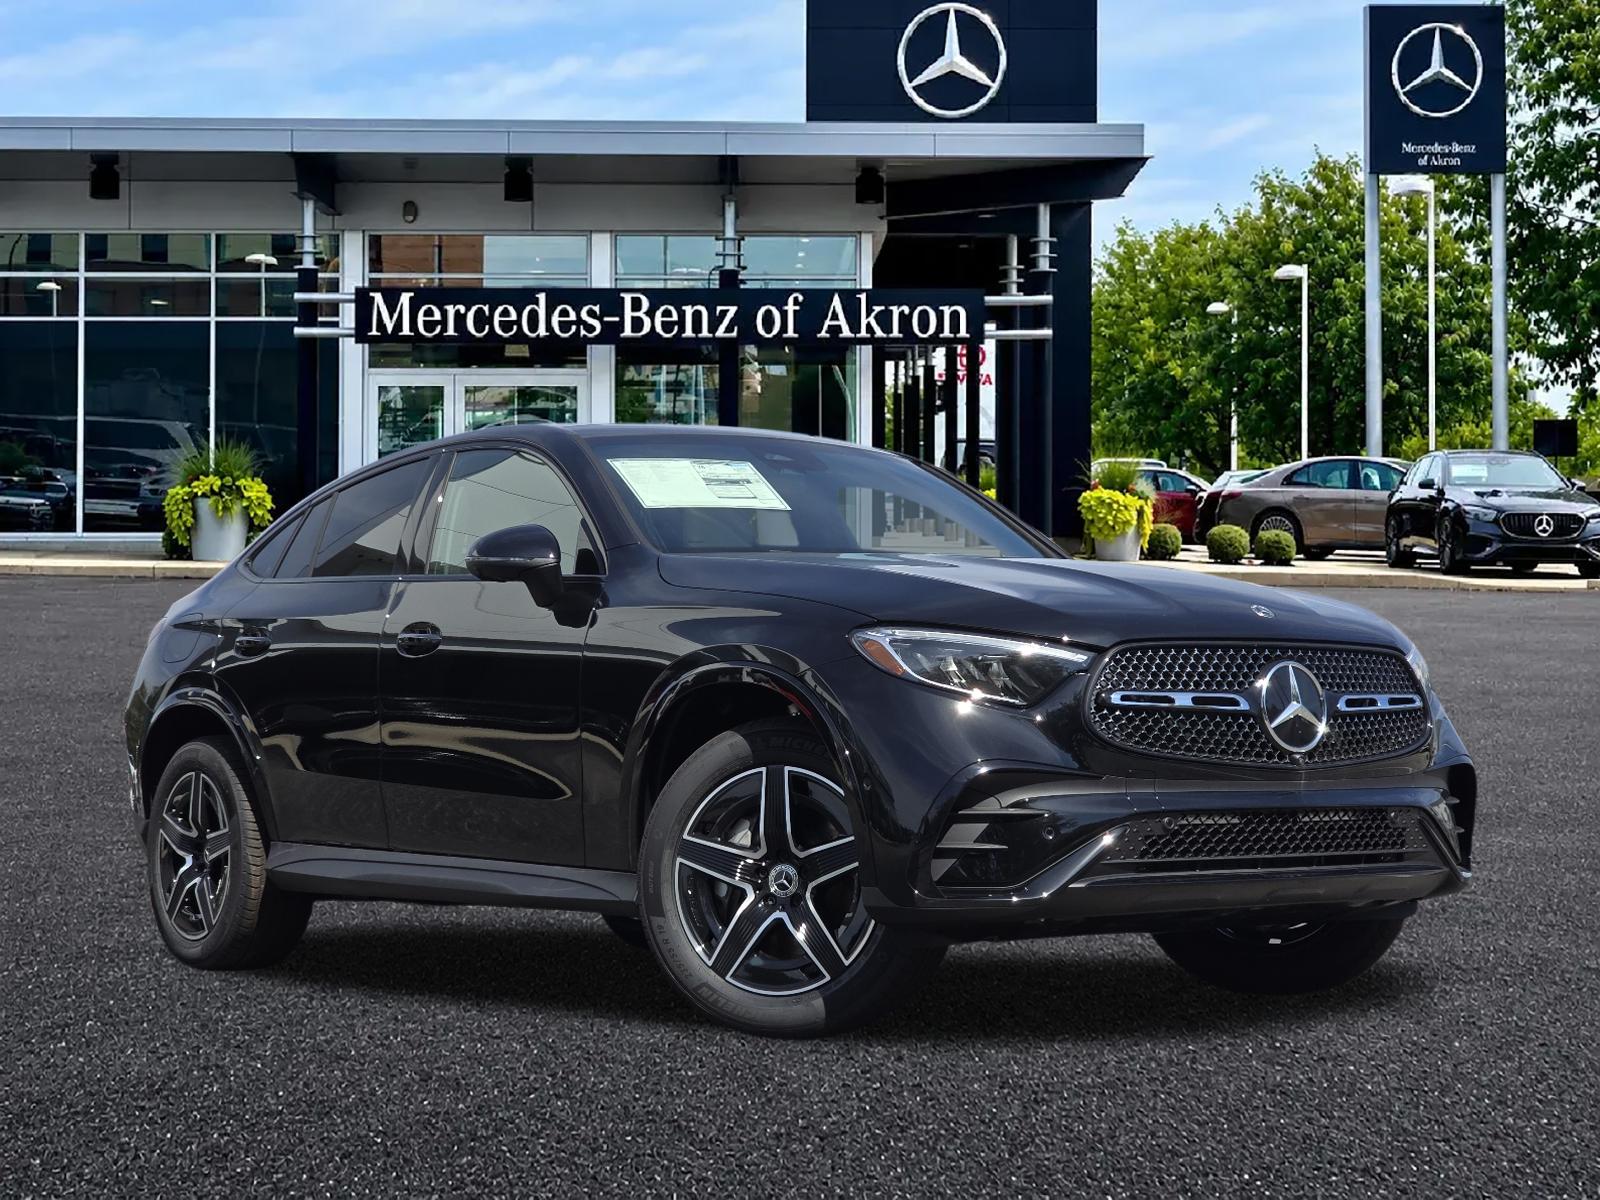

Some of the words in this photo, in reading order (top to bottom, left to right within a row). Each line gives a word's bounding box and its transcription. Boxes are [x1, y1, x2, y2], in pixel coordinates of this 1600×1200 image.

[1402, 142, 1476, 153] Mercedes-Benz
[1418, 155, 1428, 165] of
[1430, 155, 1460, 165] Akron
[368, 292, 737, 337] Mercedes-Benz
[756, 293, 803, 338] of
[817, 292, 970, 338] Akron
